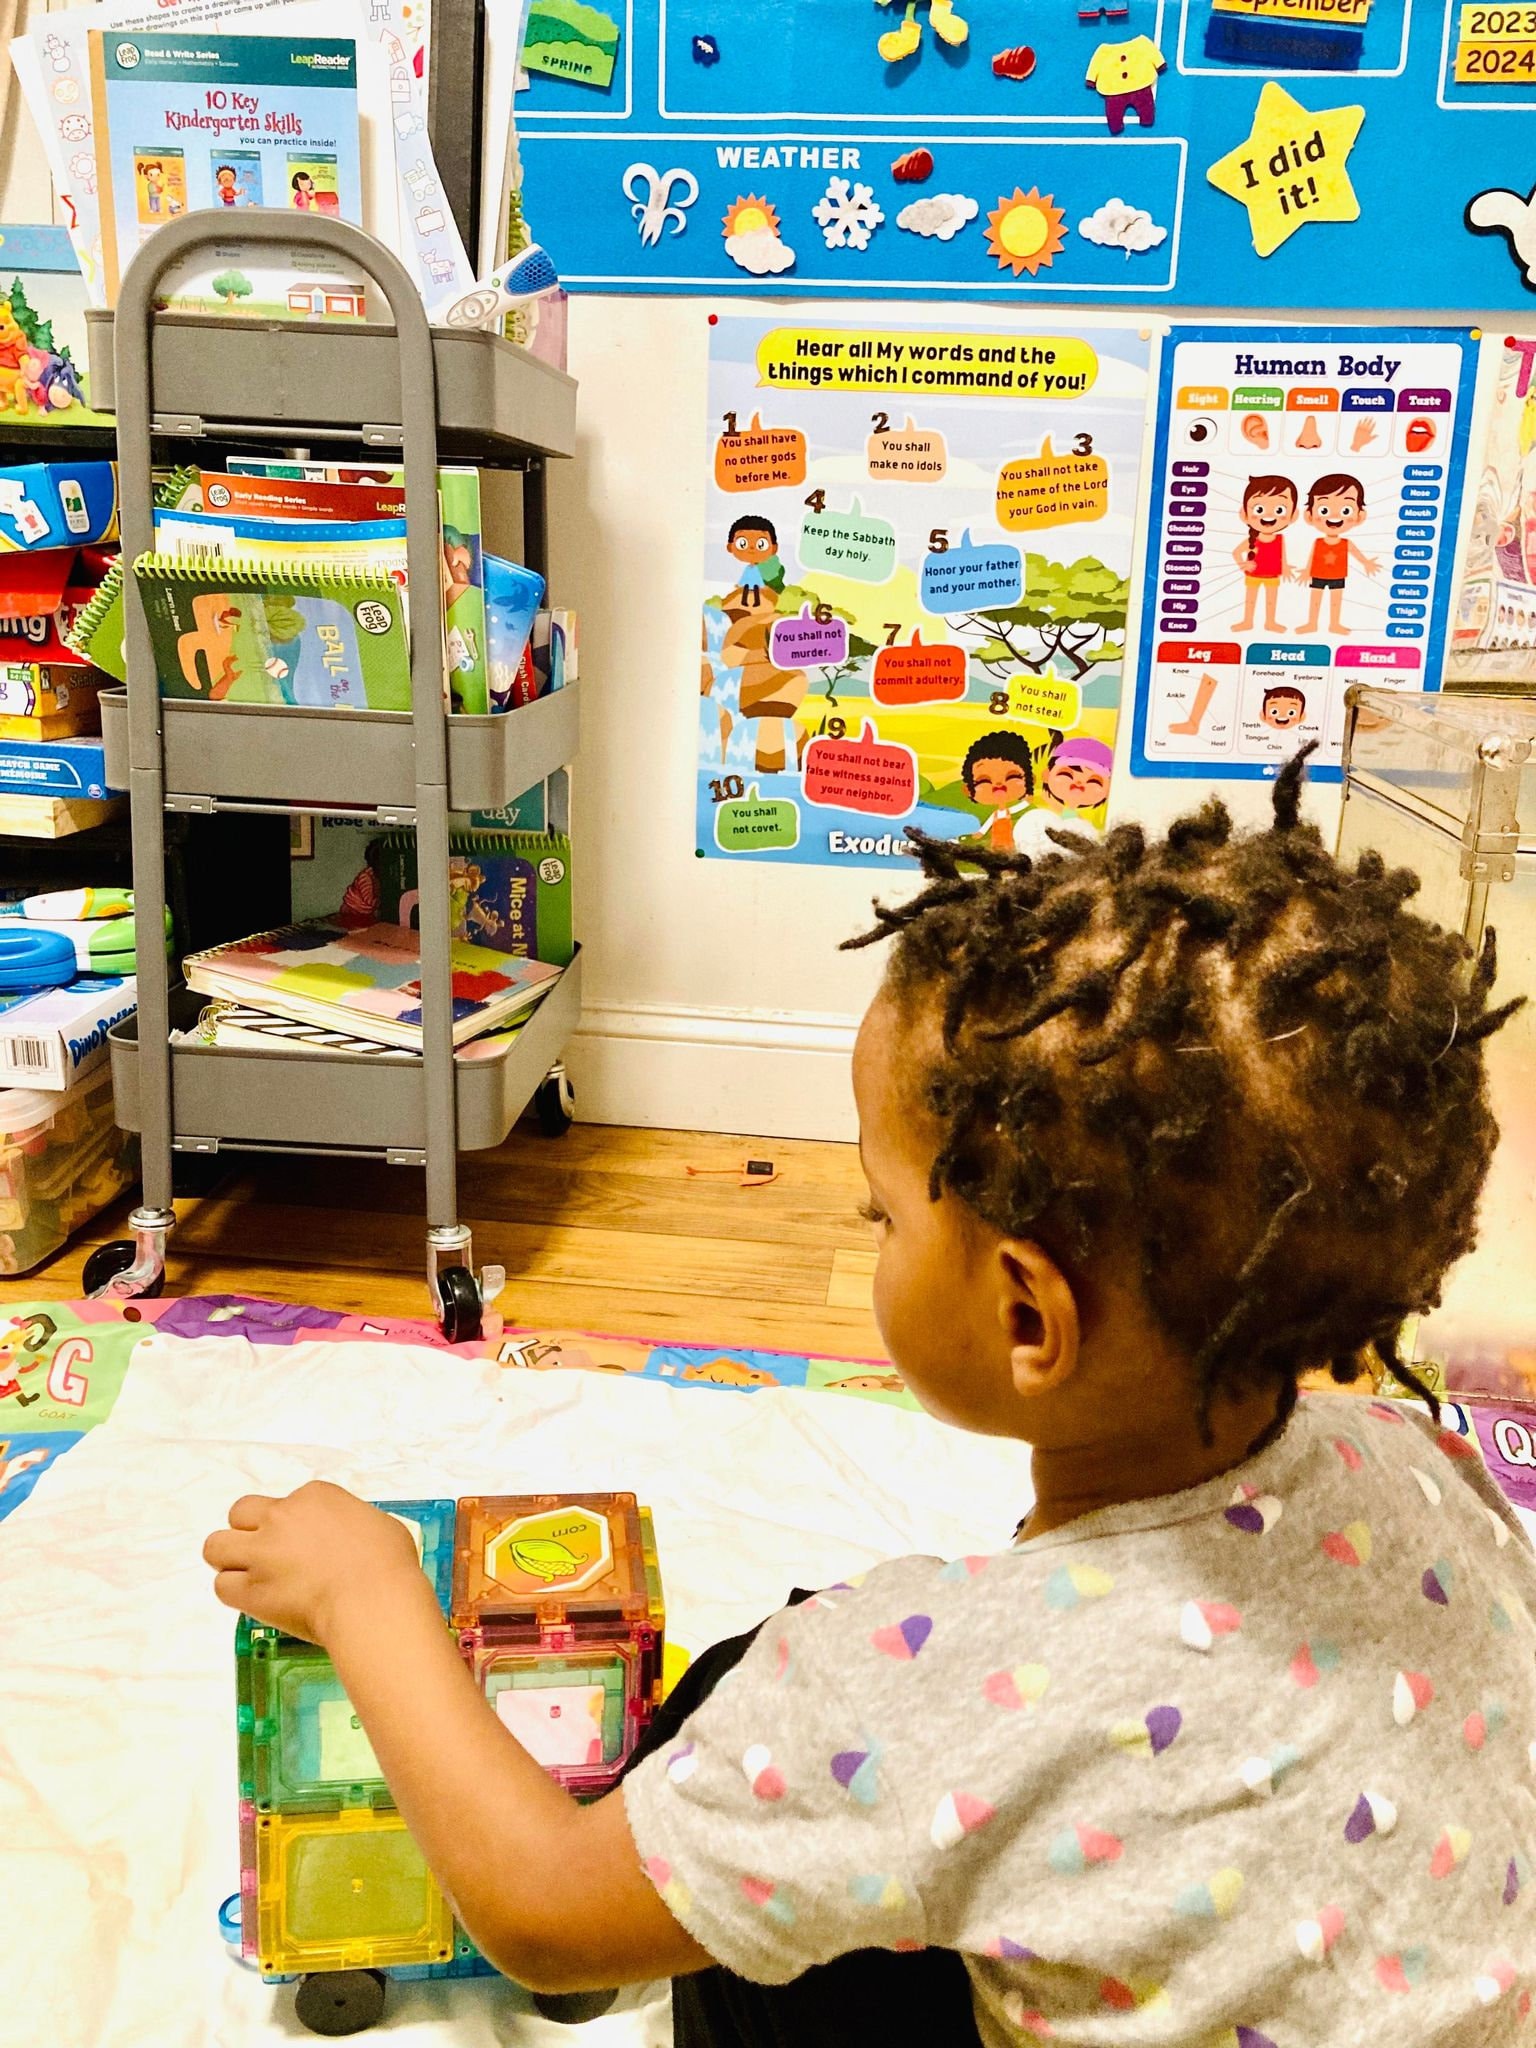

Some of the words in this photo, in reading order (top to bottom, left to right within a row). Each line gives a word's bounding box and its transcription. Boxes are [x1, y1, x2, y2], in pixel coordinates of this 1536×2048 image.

[111, 21, 123, 29] Use
[126, 17, 144, 25] these
[146, 12, 170, 22] shapes
[181, 7, 203, 15] create
[146, 21, 177, 31] drawings
[205, 12, 222, 21] page
[1470, 11, 1536, 34] 2023
[119, 47, 134, 56] Leap
[121, 56, 137, 64] Frog
[290, 53, 350, 68] LeapReader
[542, 56, 593, 75] SPRING
[1466, 50, 1535, 74] 2024
[205, 91, 226, 109] 10
[232, 93, 258, 114] Key
[165, 110, 259, 136] Kindergarten
[265, 113, 302, 135] Skills
[274, 138, 307, 147] practice
[310, 139, 336, 147] inside!
[717, 146, 860, 169] WEATHER
[1240, 159, 1260, 189] I
[1269, 131, 1326, 177] did
[1277, 177, 1320, 214] it!
[796, 339, 844, 358] Hear
[849, 342, 873, 358] all
[877, 342, 903, 363] My
[910, 344, 974, 361] words
[978, 346, 1015, 363] and
[1021, 347, 1056, 365] the
[1234, 355, 1326, 376] Human
[1338, 355, 1401, 382] Body
[768, 363, 833, 384] things
[838, 365, 898, 383] which
[903, 367, 907, 383] I
[912, 369, 1013, 388] command
[1018, 371, 1040, 389] of
[1044, 374, 1086, 392] you!
[1189, 393, 1217, 405] Sight
[1235, 393, 1280, 406] Hearing
[1296, 394, 1328, 405] Smell
[1351, 395, 1385, 406] Touch
[1409, 396, 1441, 406] Taste
[722, 412, 740, 437] 1
[871, 412, 890, 434] 2
[722, 437, 741, 448] You
[744, 435, 769, 446] shall
[772, 433, 797, 444] have
[882, 441, 902, 452] You
[905, 441, 930, 452] shall
[725, 457, 736, 466] no
[739, 452, 768, 464] other
[772, 451, 796, 464] gods
[870, 459, 897, 470] make
[899, 461, 913, 470] no
[916, 461, 942, 471] idols
[1182, 465, 1199, 473] Hair
[1411, 468, 1433, 477] Head
[736, 472, 769, 484] before
[772, 470, 790, 481] Me.
[211, 487, 225, 496] Leap
[1181, 485, 1196, 495] Eye
[1411, 489, 1430, 497] Nose
[234, 492, 252, 500] Early
[254, 493, 283, 504] Reading
[284, 495, 306, 504] Series
[804, 489, 826, 513] 4
[1181, 505, 1194, 513] Ear
[1405, 509, 1431, 518] Mouth
[804, 524, 829, 540] Keep
[832, 529, 849, 541] the
[852, 531, 895, 546] Sabbath
[1168, 524, 1203, 533] Shoulder
[1405, 529, 1426, 538] Neck
[928, 529, 949, 553] 5
[826, 546, 844, 559] day
[846, 547, 871, 562] holy.
[1172, 544, 1197, 553] Elbow
[1402, 549, 1425, 557] Chest
[925, 565, 957, 577] Honor
[959, 563, 983, 576] your
[986, 559, 1019, 571] father
[1166, 564, 1200, 573] Stomach
[1402, 569, 1419, 578] Arm
[930, 583, 949, 594] and
[951, 581, 975, 593] your
[978, 577, 1019, 591] mother.
[1170, 583, 1191, 592] Hand
[1398, 587, 1420, 597] Waist
[166, 588, 175, 609] Learn
[173, 615, 182, 632] Read
[815, 603, 832, 624] 6
[1173, 602, 1186, 613] Hip
[1395, 607, 1418, 617] Thigh
[359, 607, 378, 630] Frog
[370, 605, 388, 629] Leap
[1168, 621, 1188, 630] Knee
[1395, 626, 1414, 635] Foot
[775, 631, 794, 642] You
[797, 630, 821, 640] shall
[825, 629, 842, 639] not
[883, 624, 901, 646] 7
[317, 624, 349, 676] BALL
[791, 648, 831, 659] murder.
[1188, 648, 1212, 662] Leg
[1271, 649, 1305, 662] Head
[884, 657, 903, 668] You
[907, 656, 932, 667] shall
[935, 657, 951, 667] not
[1360, 652, 1396, 664] Hand
[875, 675, 913, 686] commit
[916, 674, 964, 687] adultery.
[1294, 674, 1323, 682] Eyebrow
[1384, 677, 1406, 685] Finger
[1021, 684, 1040, 696] You
[1043, 689, 1067, 701] shall
[988, 692, 1009, 714] 8
[1016, 702, 1033, 713] not
[1036, 705, 1063, 719] steal.
[33, 761, 60, 771] GAME
[709, 775, 744, 802] 10
[732, 807, 752, 818] You
[755, 807, 777, 817] shall
[733, 824, 750, 834] not
[752, 822, 781, 833] covet.
[543, 863, 553, 882] Frog
[551, 860, 561, 880] Leap
[510, 877, 527, 922] Mice
[512, 924, 522, 938] at
[47, 1337, 93, 1407] G
[38, 1409, 77, 1420] GOAT
